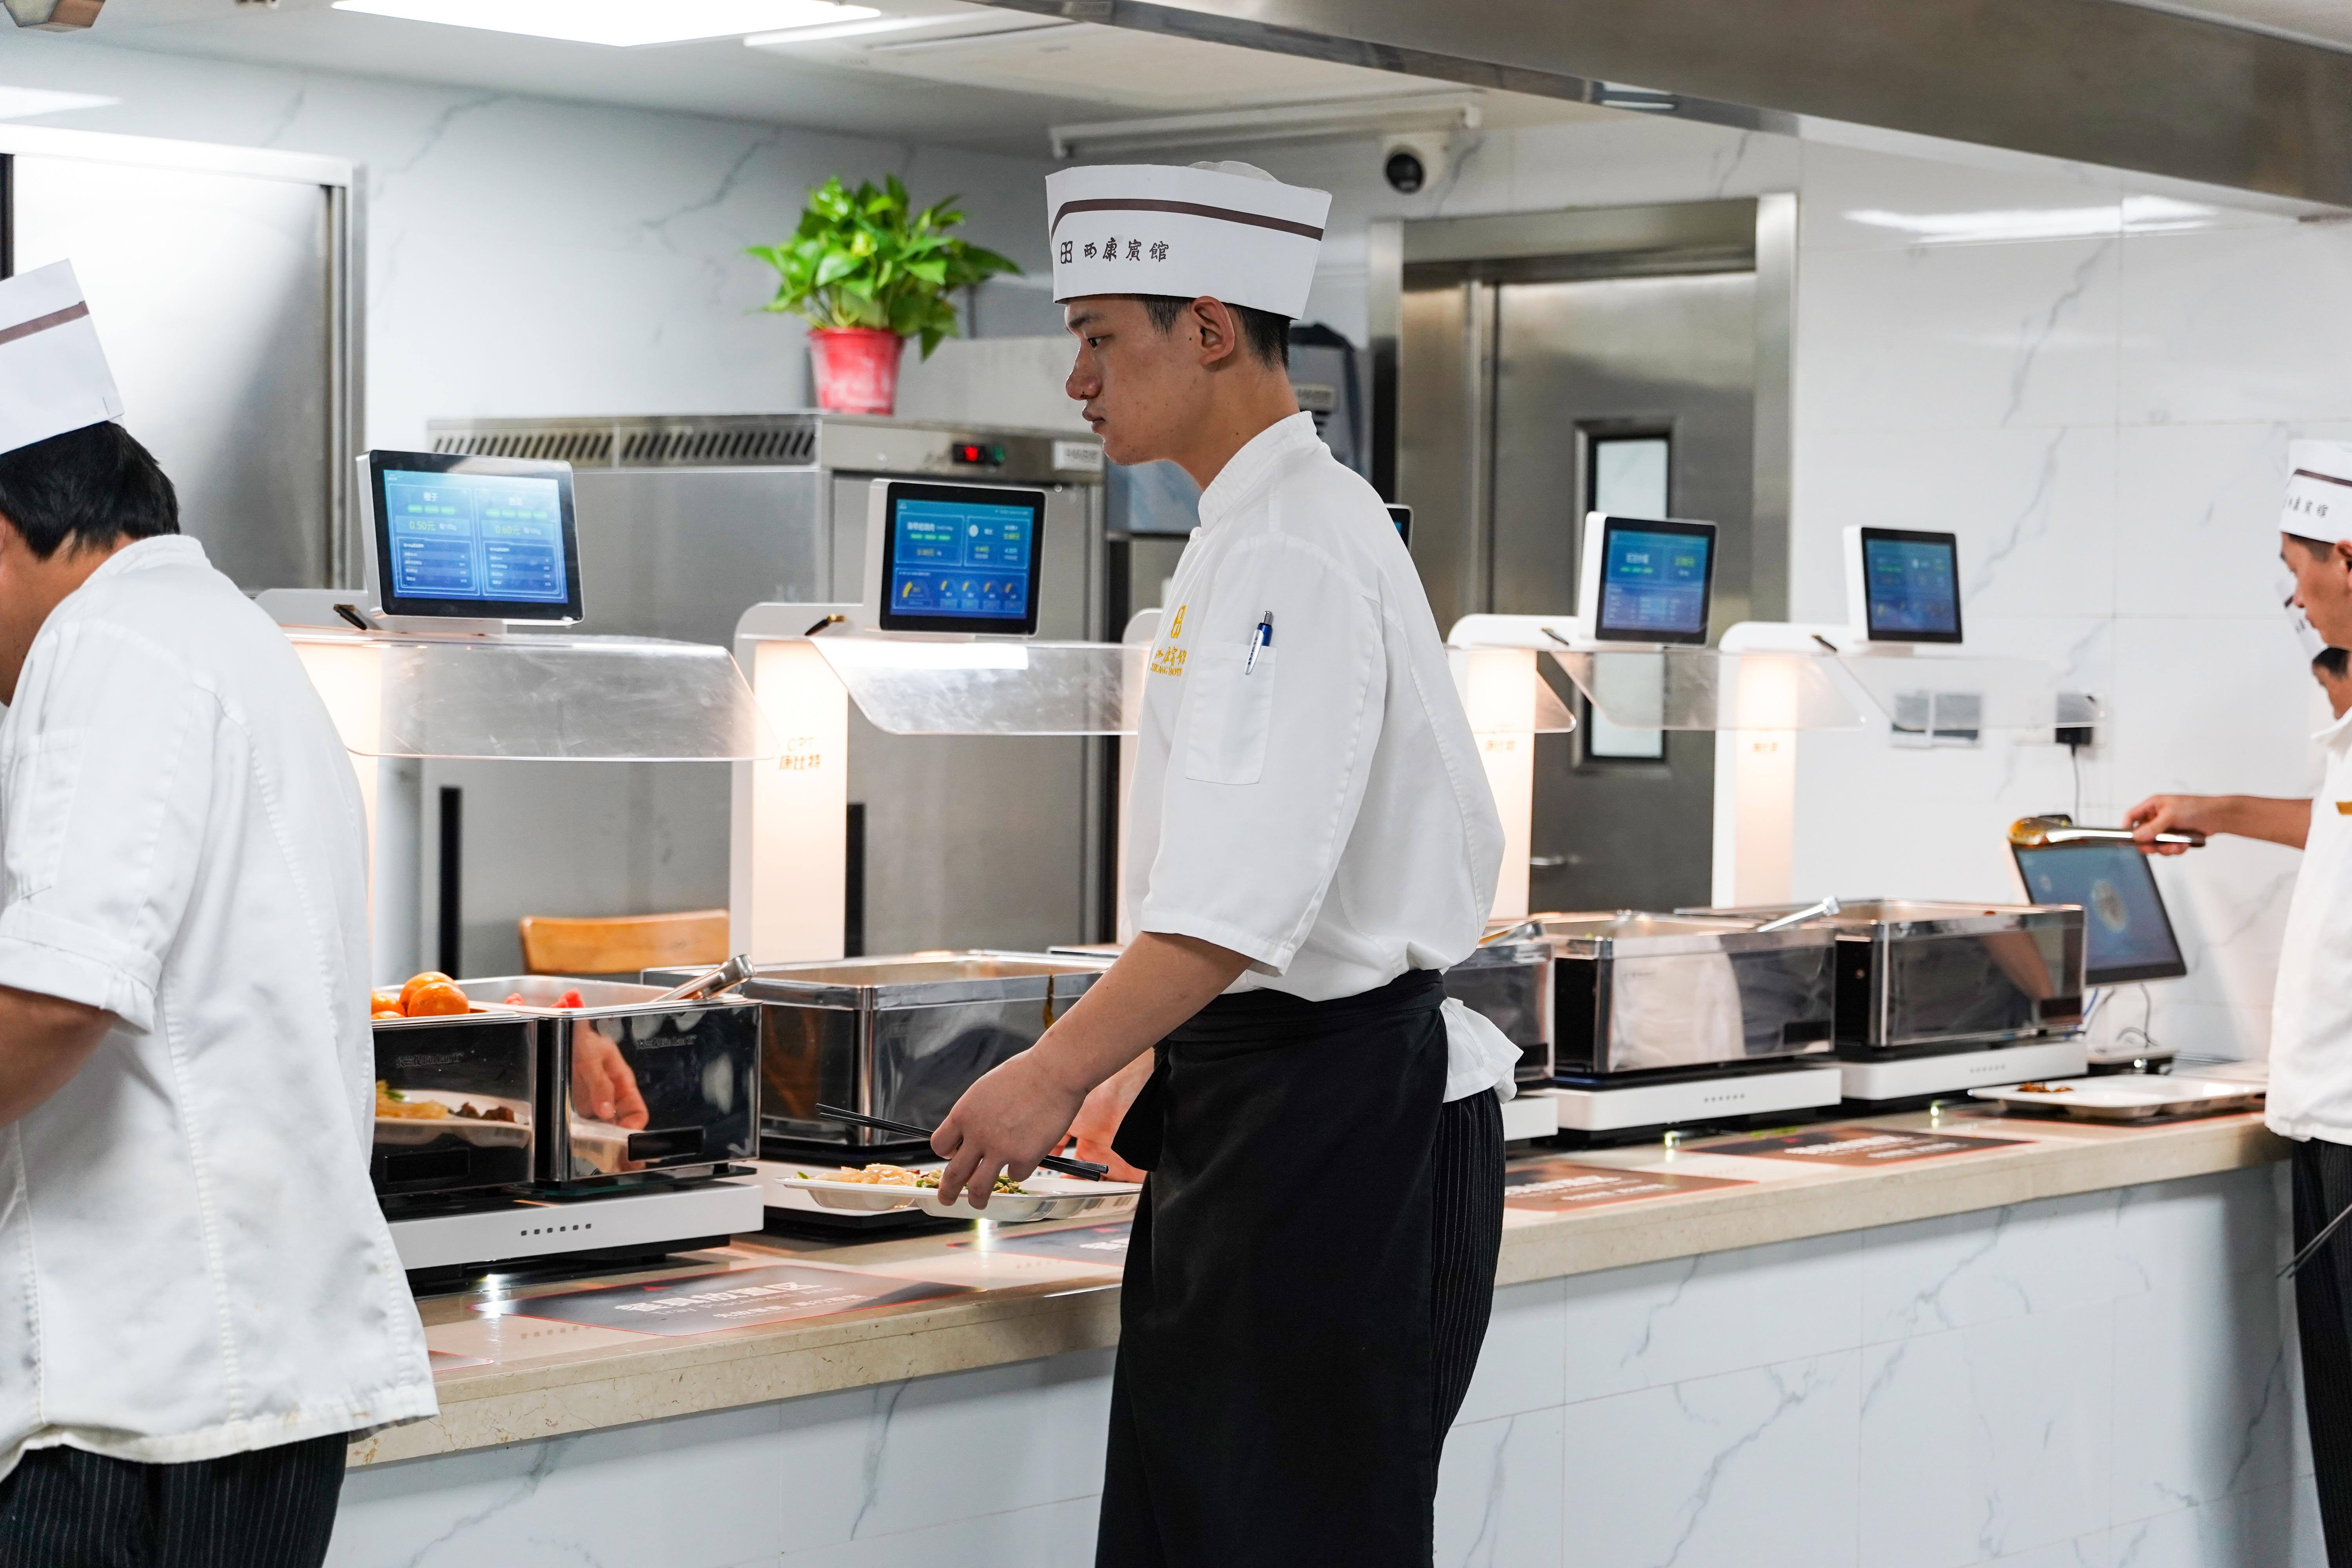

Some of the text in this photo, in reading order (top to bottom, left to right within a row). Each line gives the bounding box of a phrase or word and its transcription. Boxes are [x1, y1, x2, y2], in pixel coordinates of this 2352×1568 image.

[1084, 237, 1169, 262] 西康賓館
[614, 1281, 822, 1312] 餐具放置区
[698, 1294, 798, 1308] Placement
